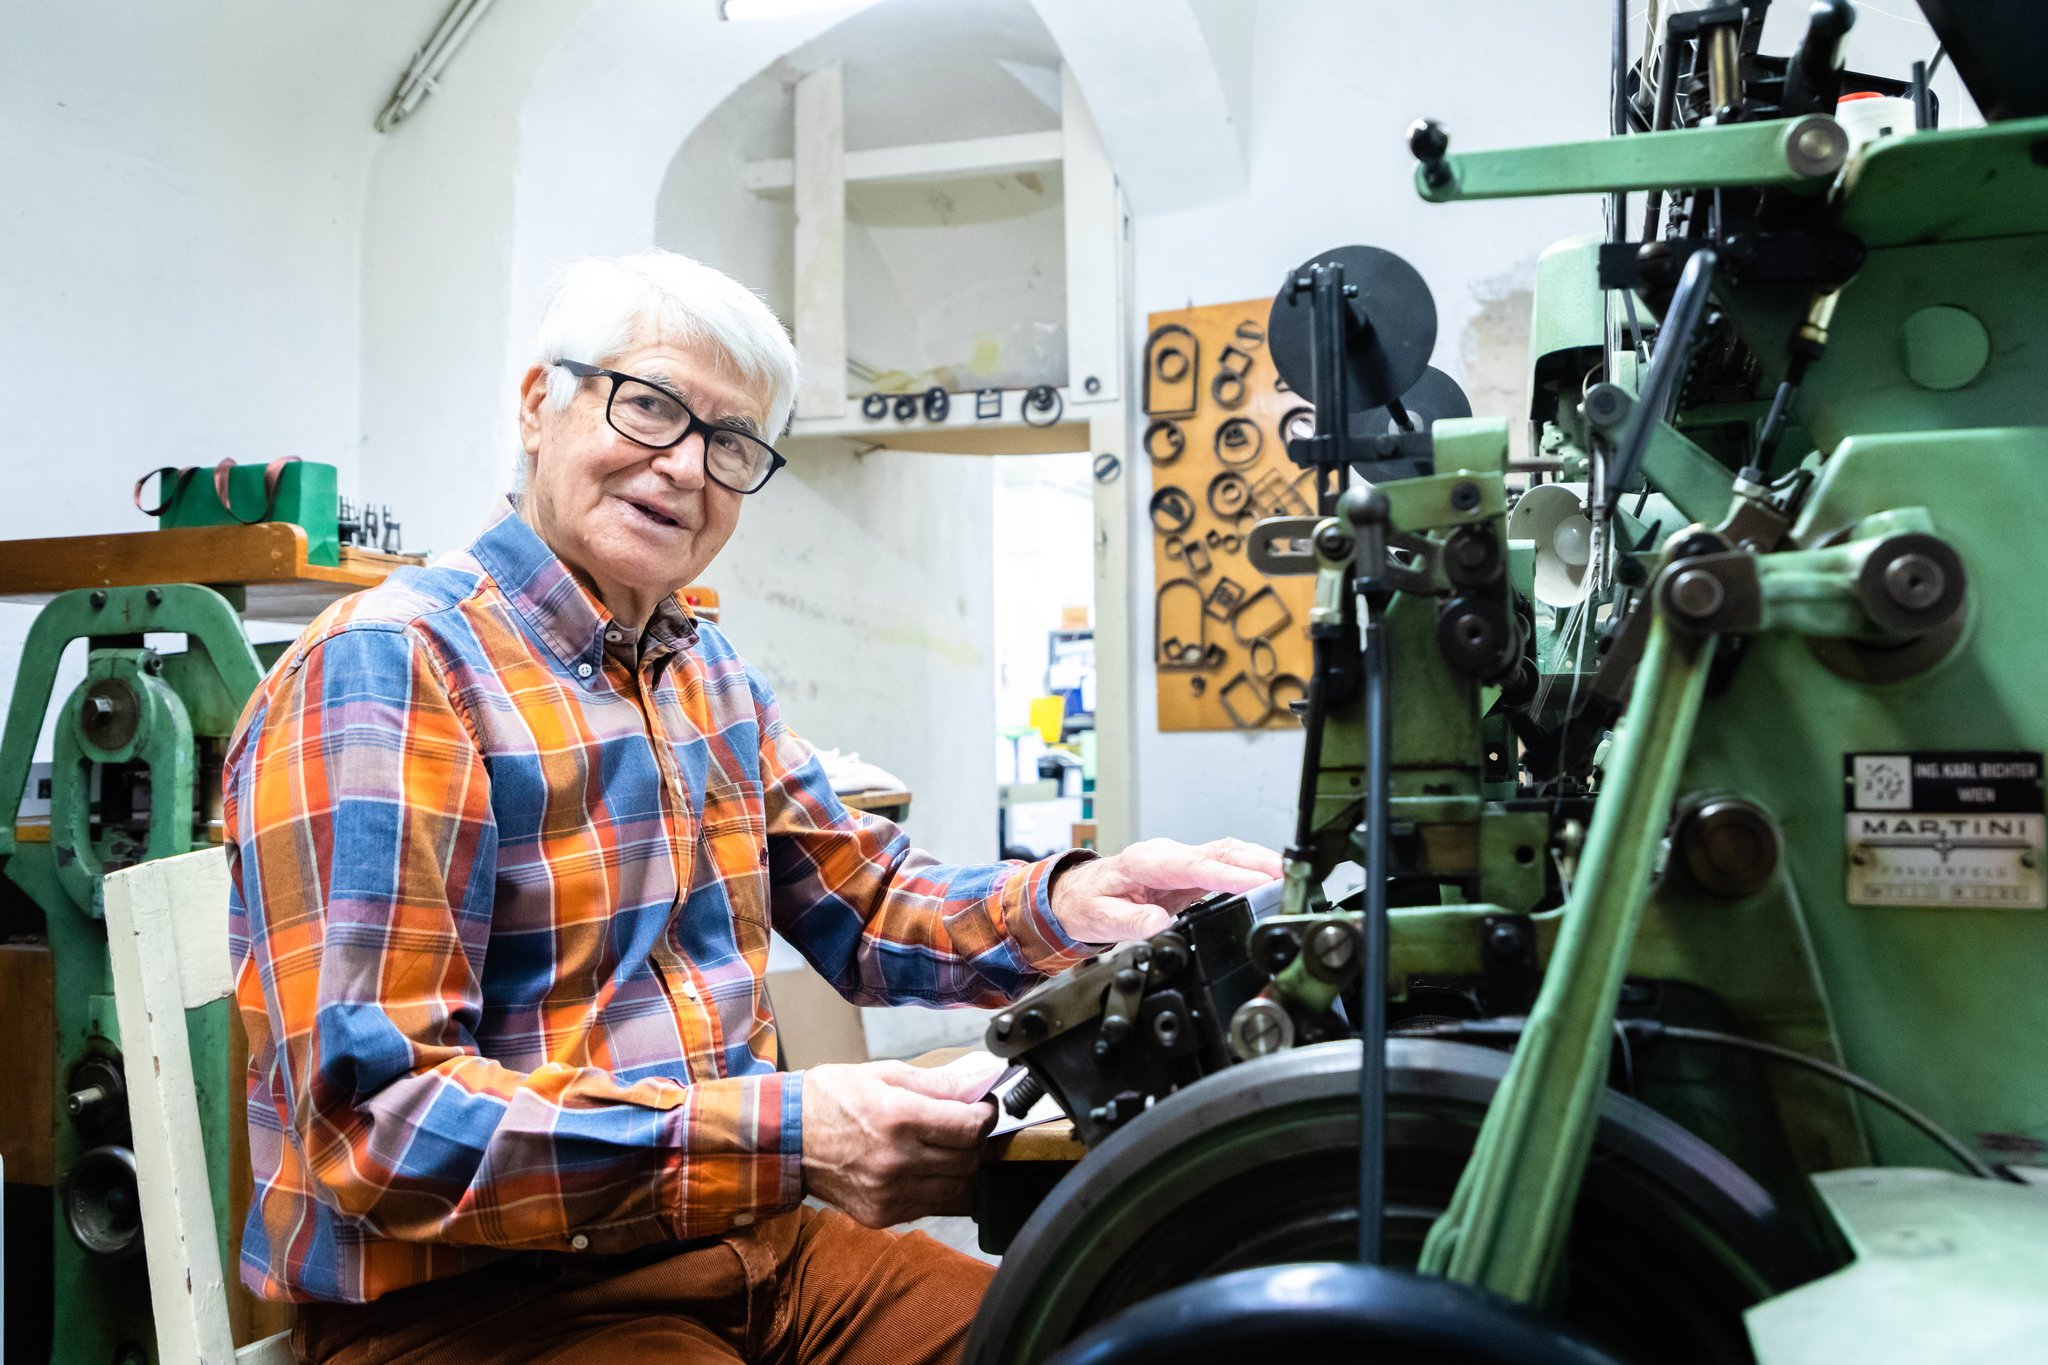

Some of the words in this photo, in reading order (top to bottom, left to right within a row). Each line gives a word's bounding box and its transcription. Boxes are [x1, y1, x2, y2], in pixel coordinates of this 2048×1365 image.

[1942, 762, 1976, 778] KARL
[1979, 762, 2037, 779] RICHTER
[1863, 820, 2026, 835] MARTINI
